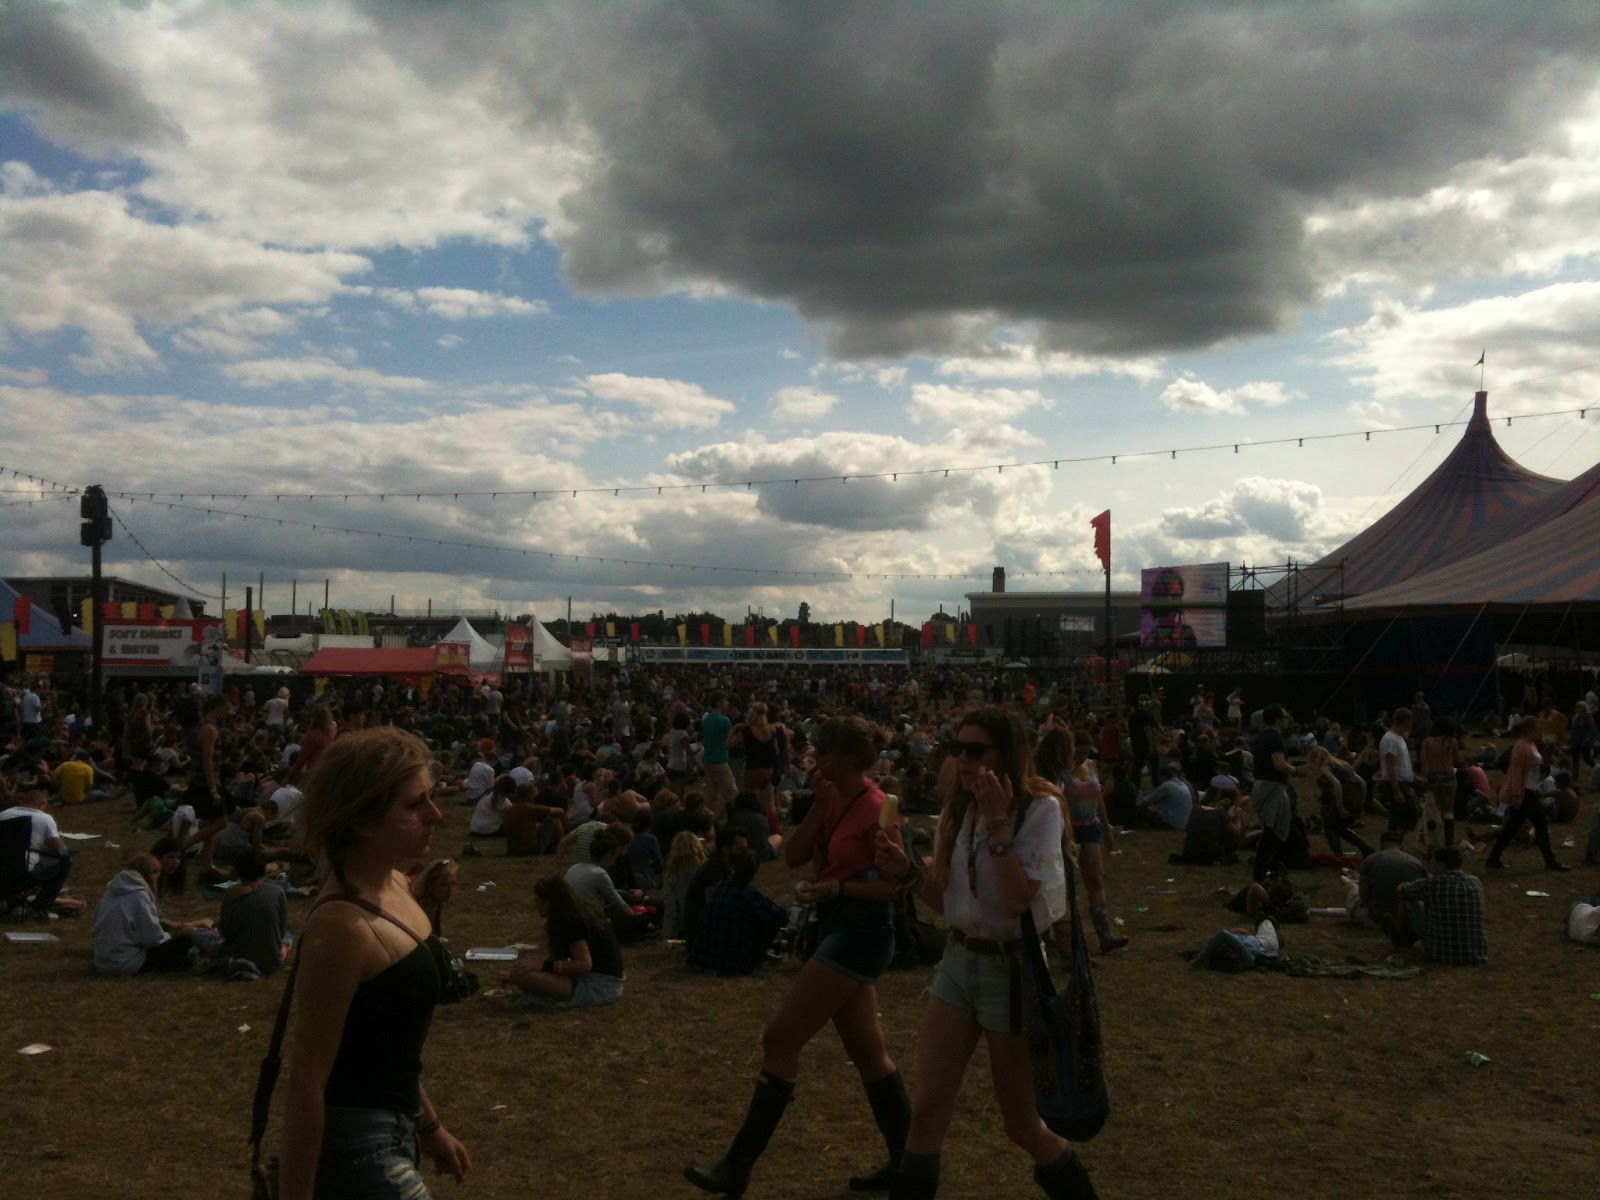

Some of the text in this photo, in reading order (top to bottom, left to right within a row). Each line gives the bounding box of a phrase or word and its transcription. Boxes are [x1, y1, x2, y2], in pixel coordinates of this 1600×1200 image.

[109, 629, 183, 640] SOFT DRINKS
[120, 644, 160, 655] WATER
